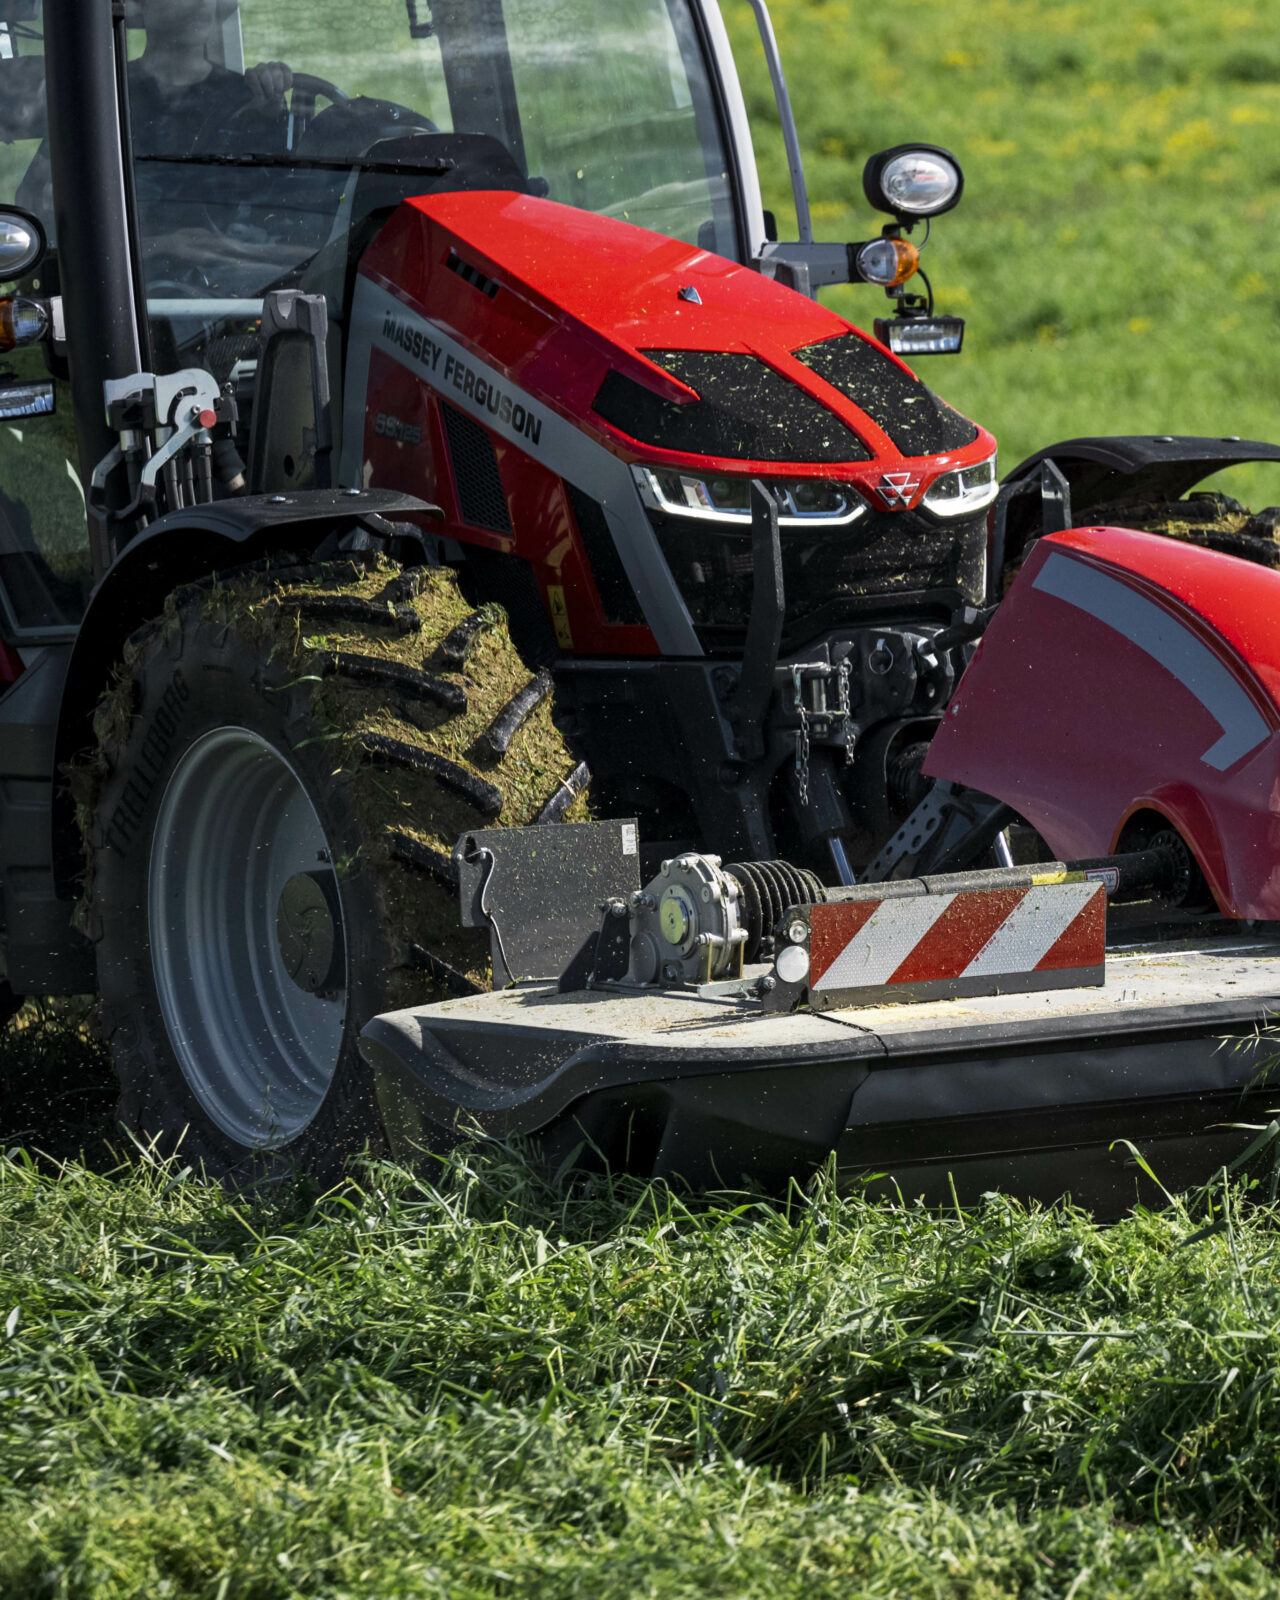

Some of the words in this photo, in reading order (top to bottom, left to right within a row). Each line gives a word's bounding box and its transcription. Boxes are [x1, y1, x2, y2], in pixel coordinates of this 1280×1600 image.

[382, 311, 442, 371] MASSEY
[444, 354, 542, 445] FERGUSON
[105, 669, 190, 858] TRELLEBORG
